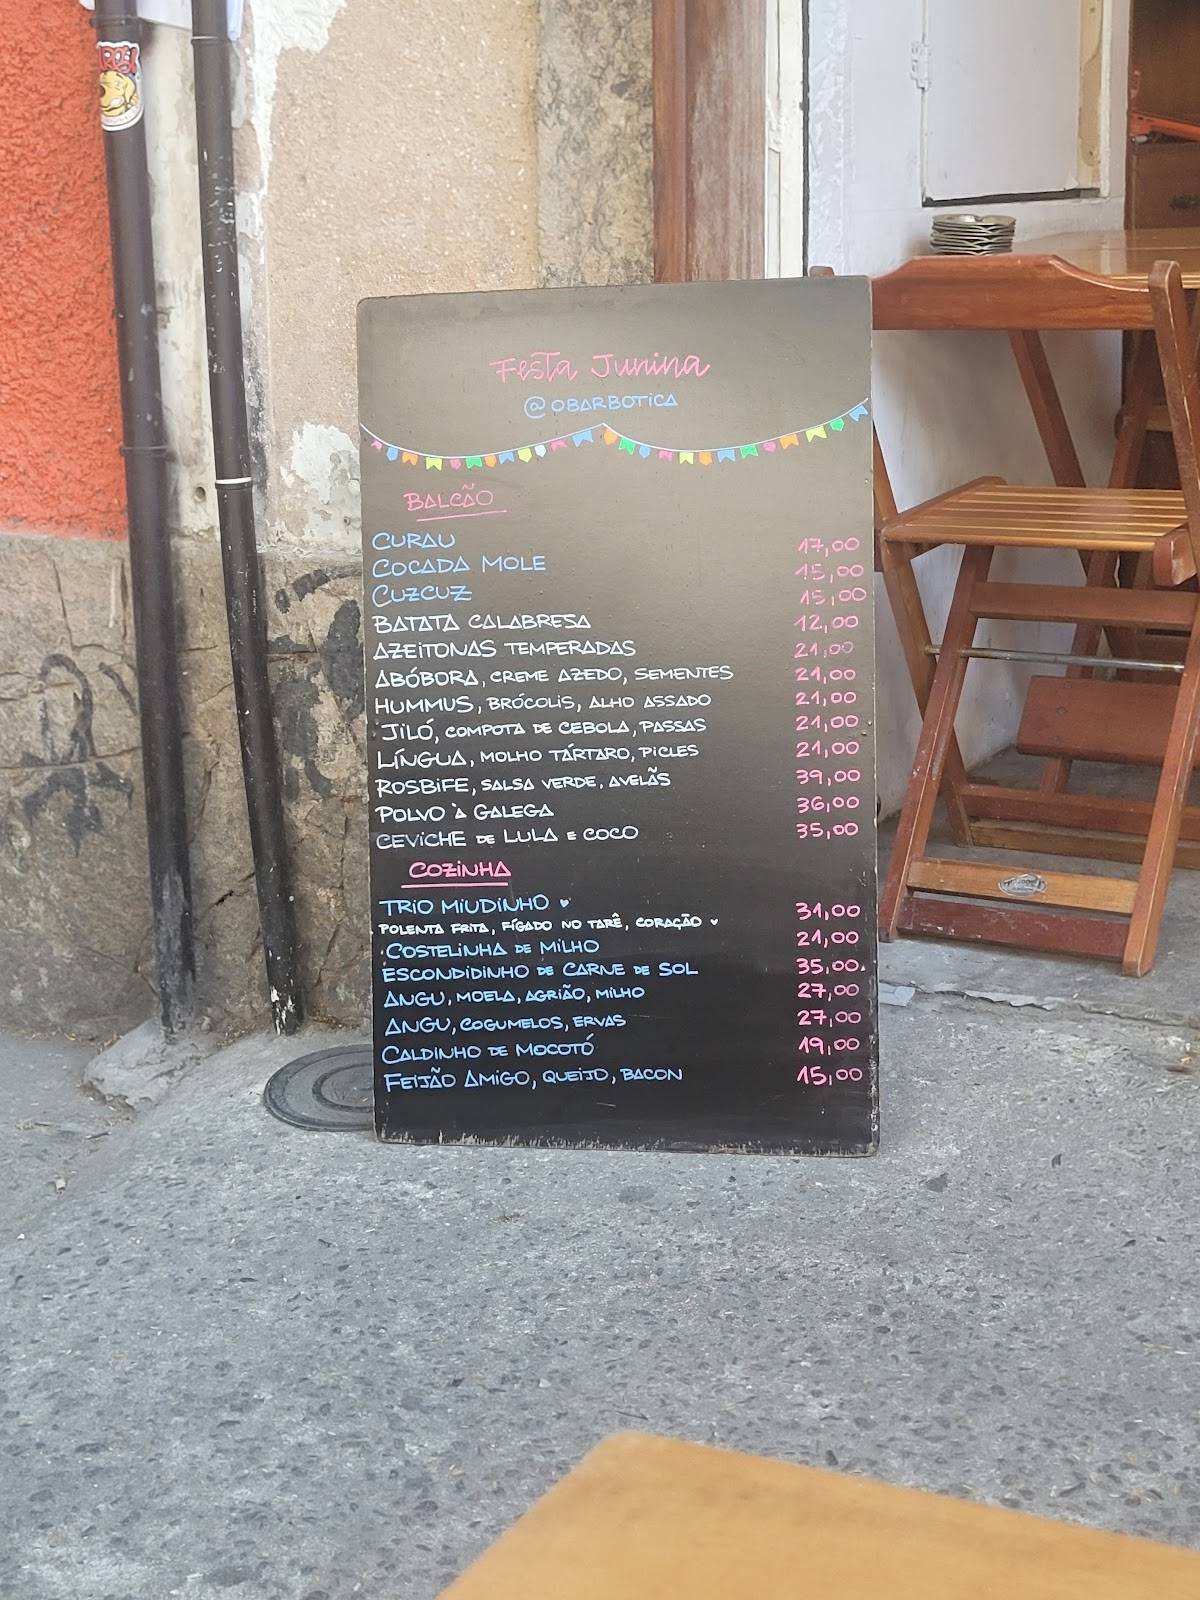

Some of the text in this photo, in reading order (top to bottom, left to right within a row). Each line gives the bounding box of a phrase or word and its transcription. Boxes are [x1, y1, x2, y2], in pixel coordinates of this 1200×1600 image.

[489, 351, 710, 383] Festa Junina
[403, 483, 494, 512] BALCÃO
[372, 532, 456, 551] CURAU
[798, 537, 860, 557] 17,00
[372, 554, 546, 579] COCADA MOLE
[795, 563, 864, 583] 15,00
[372, 584, 472, 607] CUZCUZ
[800, 587, 866, 606] 15,00
[372, 614, 592, 634] BATATA CALABRESA
[793, 615, 859, 633] 12,00
[373, 639, 636, 661] AZEITONAS TEMPERADAS
[794, 641, 854, 658] 21,00
[375, 665, 734, 689] ABÓBORA, CREME AZEDO, SEMENTES
[795, 666, 856, 684] 21,00
[374, 693, 712, 715] HUMMUS, BRÓCOLIS, ALHO ASSADO
[795, 691, 856, 707] 21,00
[381, 719, 708, 744] JILÓ, COMPOTA DE CEBOLA, PASSAS
[796, 715, 859, 733] 21,00
[376, 743, 700, 770] LÍNGUA, MOLHO TÁRTARO, PICLES
[796, 740, 859, 758] 21,00
[376, 766, 672, 797] ROSBIFE, SALSA VERDE, AVELÃS
[796, 769, 861, 786] 39,00
[375, 804, 446, 824] POLVO
[472, 803, 555, 819] GALEGA
[796, 796, 859, 813] 36,00
[376, 825, 639, 850] CEVICHE DE LULA E COCO
[796, 822, 859, 839] 35,00
[408, 859, 512, 878] COZINHA
[379, 893, 550, 916] TRIO MIUDINHO
[796, 902, 860, 921] 31,00
[378, 911, 702, 936] POLENTA FRITA, FÍGADO NO TARÊ, CORAÇÃO
[796, 929, 859, 948] 21,00
[385, 938, 600, 960] COSTELINHA DE MILHO
[382, 961, 699, 983] ESCONDIDINHO DE CARNE DE SOL
[796, 958, 859, 974] 35,00
[383, 983, 646, 1009] ANGU, MOELA, AGRIÃO, MILHO
[797, 982, 860, 1002] 27,00
[384, 1014, 627, 1037] ANGU, COGUMELOS, ERVAS
[797, 1009, 862, 1027] 27,00
[381, 1033, 595, 1065] CALDINHO DE MOCOTÓ
[799, 1036, 860, 1055] 19,00
[383, 1066, 684, 1093] FEIJÃO AMIGO, QUEIJO, BACON
[797, 1066, 863, 1086] 15,00
